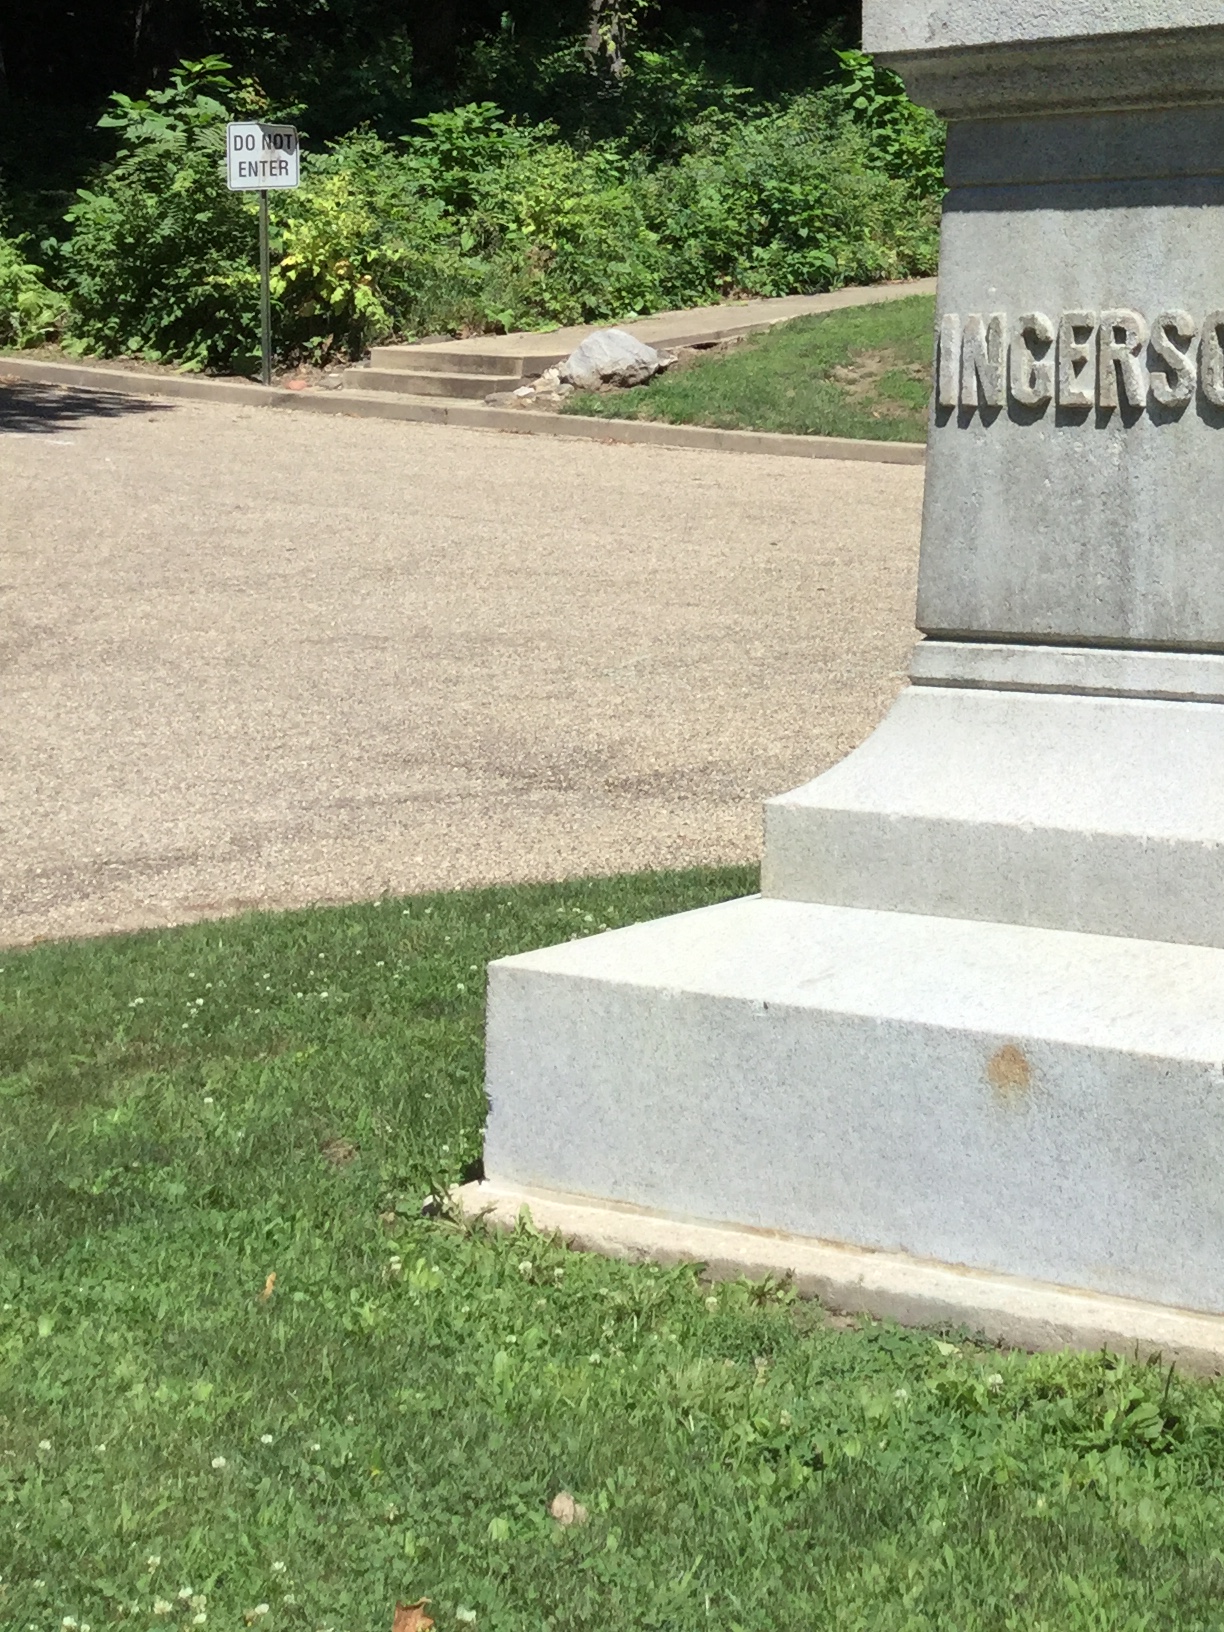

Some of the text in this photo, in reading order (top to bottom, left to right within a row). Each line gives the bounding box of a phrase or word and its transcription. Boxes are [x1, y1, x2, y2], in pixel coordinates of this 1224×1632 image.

[233, 133, 292, 151] DO NOT
[238, 160, 289, 178] ENTER
